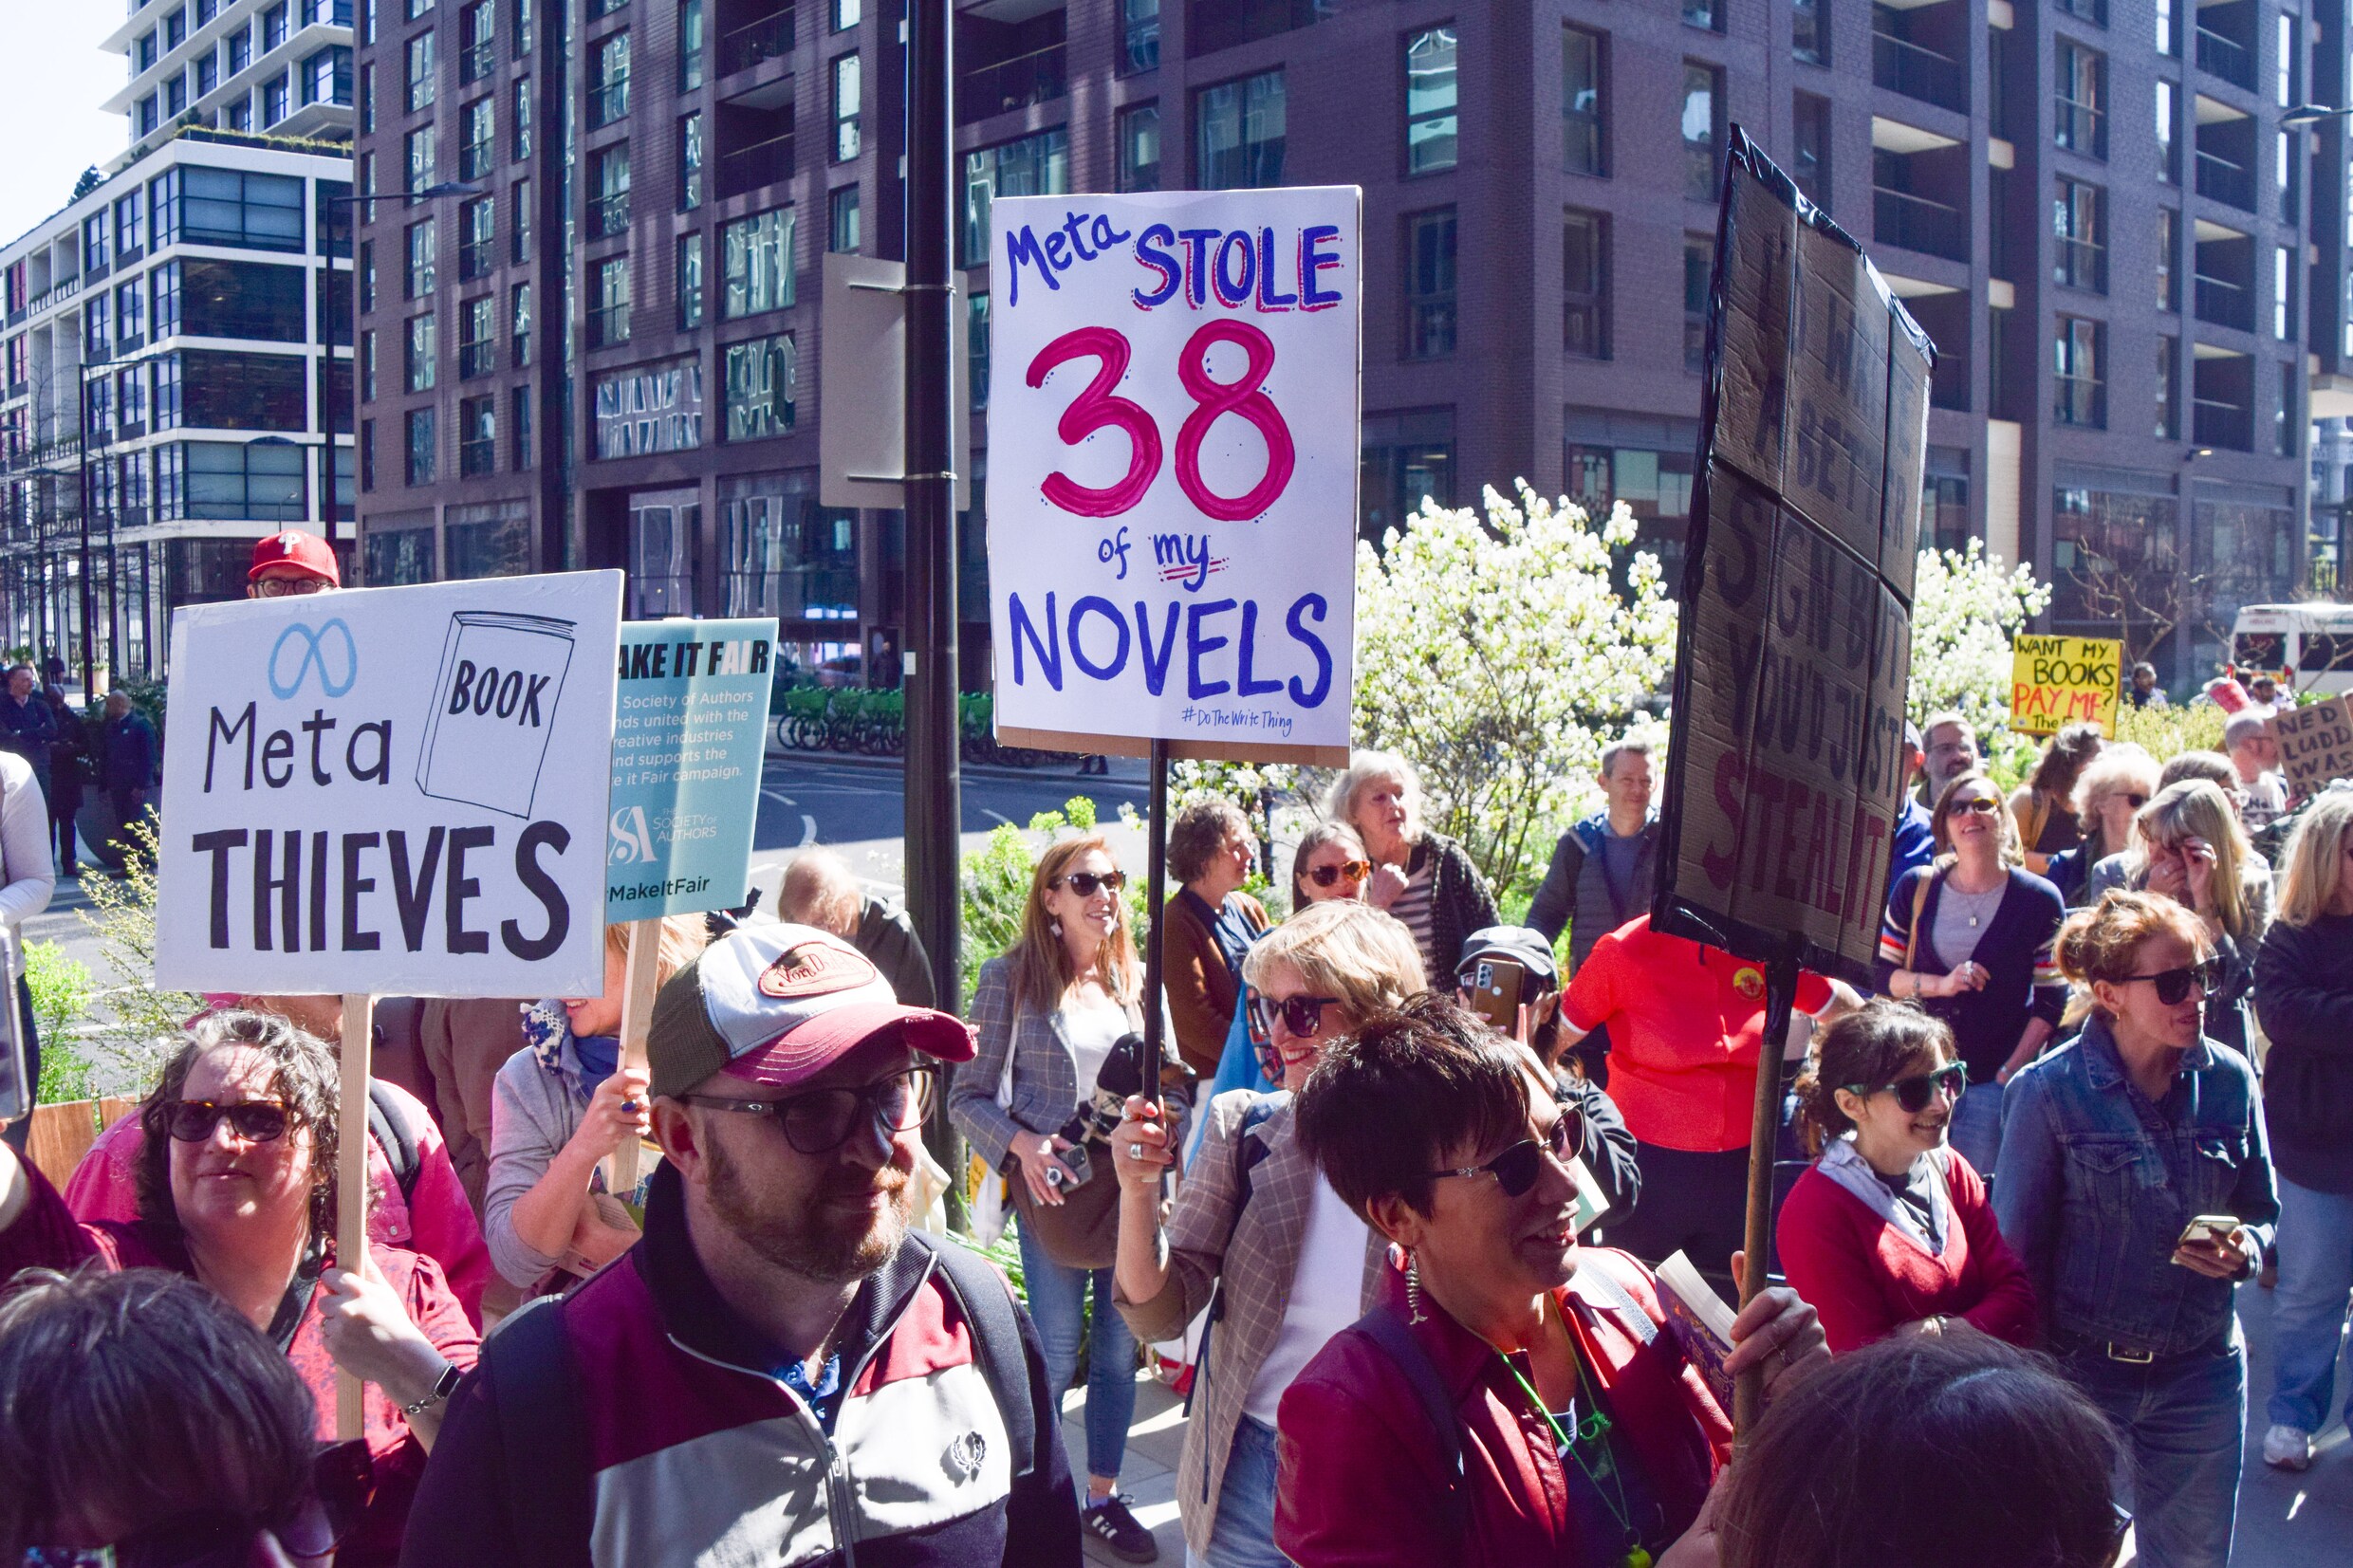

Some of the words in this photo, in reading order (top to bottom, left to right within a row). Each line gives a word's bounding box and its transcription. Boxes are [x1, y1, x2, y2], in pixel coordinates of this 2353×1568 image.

[1007, 212, 1131, 307] Meta
[1132, 223, 1343, 312] STOLE
[1026, 318, 1296, 522] 38
[278, 532, 301, 555] P
[1098, 526, 1132, 581] of
[1153, 533, 1210, 593] my
[1715, 482, 1837, 653] SGN
[1845, 565, 1905, 691] BUT
[619, 643, 668, 680] AKE
[674, 642, 703, 677] IT
[707, 639, 769, 676] FAIR
[1009, 590, 1333, 709] NOVELS
[2017, 637, 2069, 657] WANT
[2082, 642, 2109, 659] MY
[2033, 658, 2117, 687] BOOKS
[448, 659, 551, 728] BOOK
[622, 693, 677, 710] Society
[681, 692, 696, 706] of
[699, 691, 754, 705] Authors
[2013, 682, 2064, 716] PAY
[615, 715, 639, 729] nds
[644, 712, 689, 728] united
[694, 710, 722, 724] with
[727, 710, 749, 722] the
[1728, 622, 1826, 762] YOU'D
[1829, 688, 1899, 799] JUST
[2032, 713, 2059, 729] The
[2276, 707, 2338, 735] NED
[203, 701, 392, 793] Meta
[613, 733, 662, 748] reative
[666, 729, 733, 745] industries
[2282, 726, 2352, 761] LUDD
[638, 751, 701, 767] supports
[705, 747, 728, 760] the
[2291, 750, 2353, 779] WAS
[626, 772, 638, 785] it
[641, 770, 669, 784] Fair
[673, 766, 743, 782] campaign.
[653, 814, 707, 830] SOCIETY
[656, 826, 717, 843] AUTHORS
[1702, 748, 1842, 916] STEAL
[193, 821, 571, 961] THIEVES
[607, 876, 711, 902] MakeItFair
